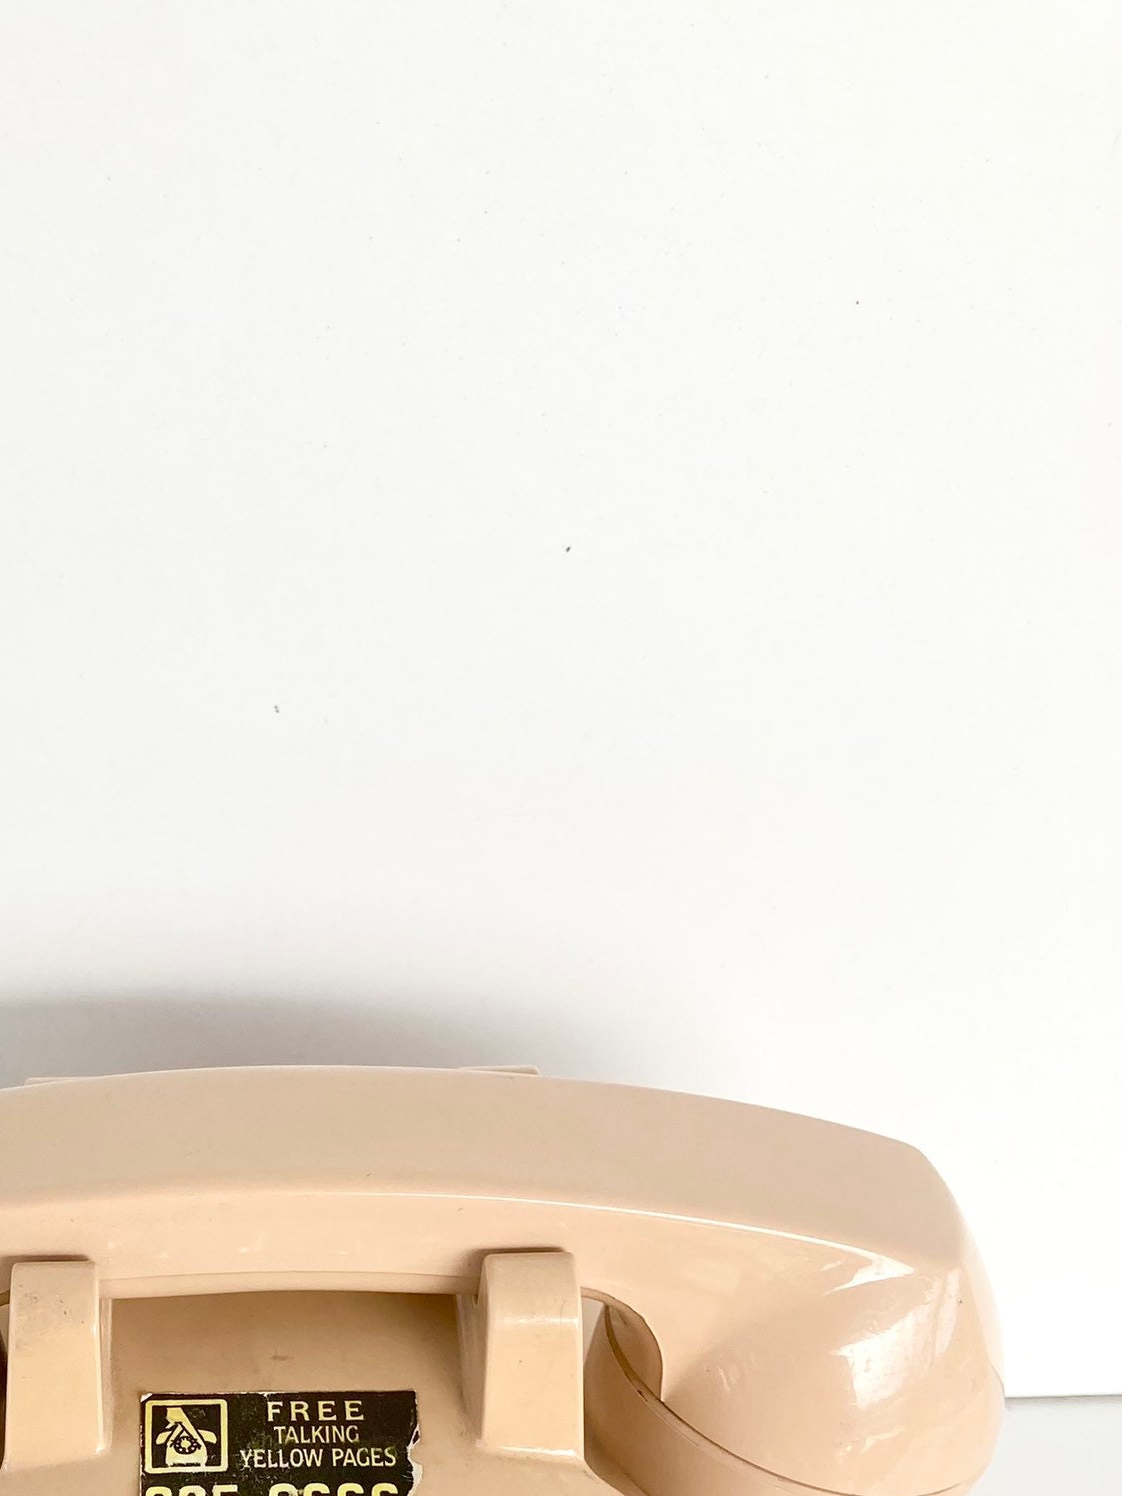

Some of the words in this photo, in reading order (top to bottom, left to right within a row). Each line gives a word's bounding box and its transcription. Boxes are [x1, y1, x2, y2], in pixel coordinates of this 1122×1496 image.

[266, 1400, 365, 1422] FREE
[273, 1425, 360, 1445] TALKING
[239, 1448, 324, 1469] YELLOW
[331, 1447, 397, 1468] PAGES
